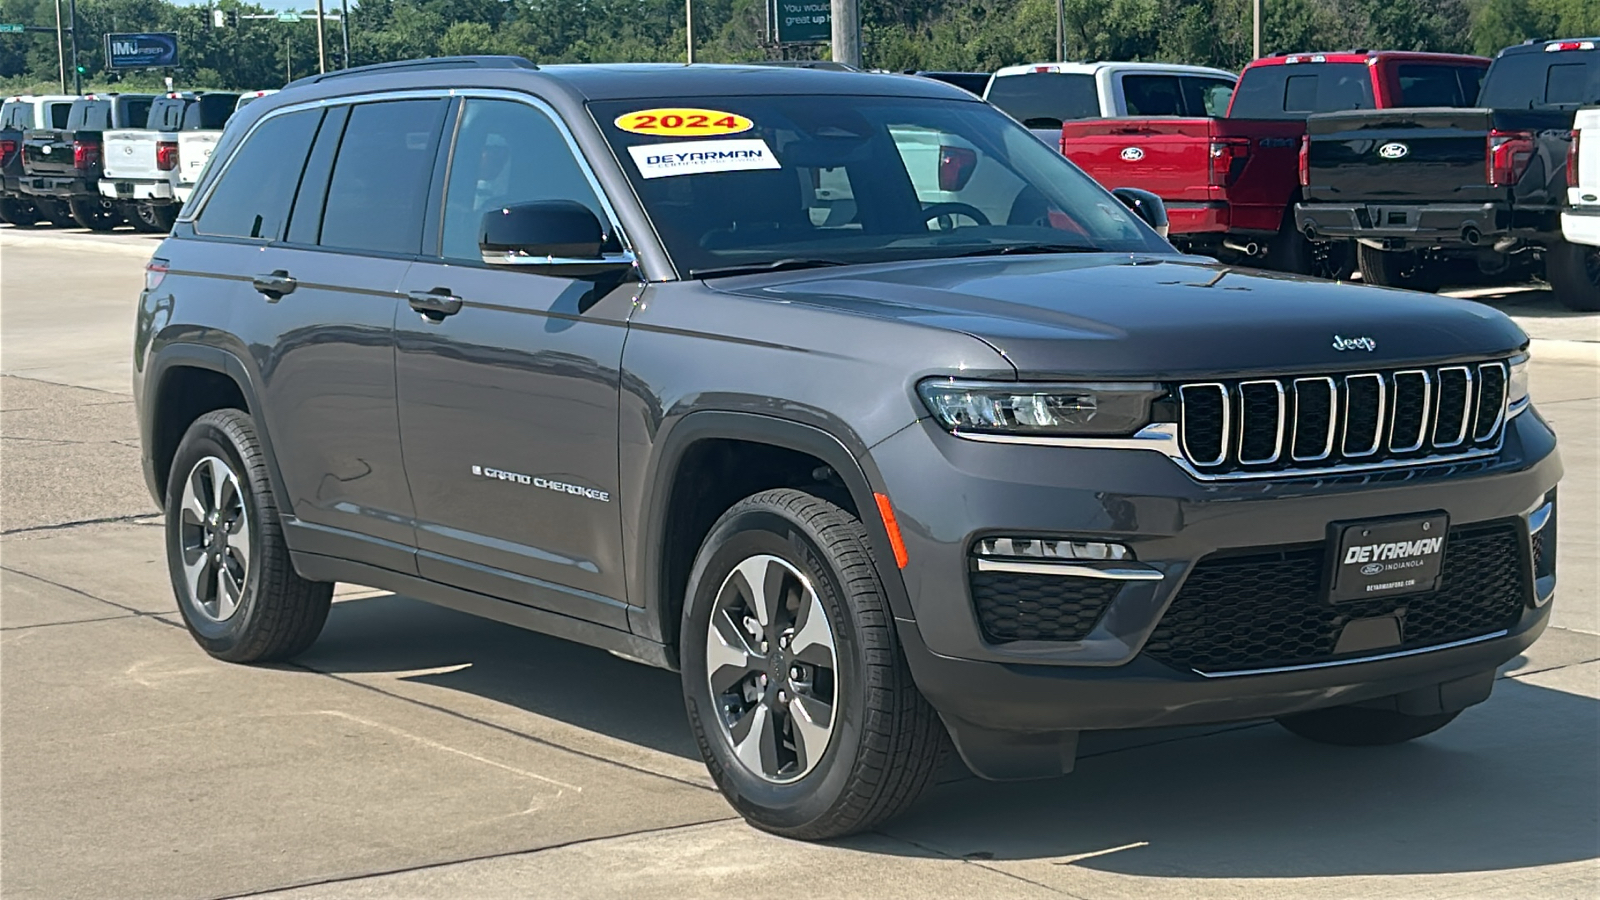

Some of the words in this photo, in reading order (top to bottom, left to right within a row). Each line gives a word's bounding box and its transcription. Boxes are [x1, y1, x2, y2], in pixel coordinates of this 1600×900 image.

[784, 4, 802, 13] You
[785, 16, 811, 26] great
[812, 15, 826, 25] up
[112, 40, 138, 55] IMU
[633, 115, 738, 129] 2024
[647, 150, 762, 165] DEYARMAN
[1332, 334, 1376, 352] Jeep
[484, 467, 532, 485] GRAND
[533, 477, 610, 502] CHEROKEE
[1344, 537, 1442, 564] DEYARMAN
[1384, 559, 1424, 571] INDIANOLA
